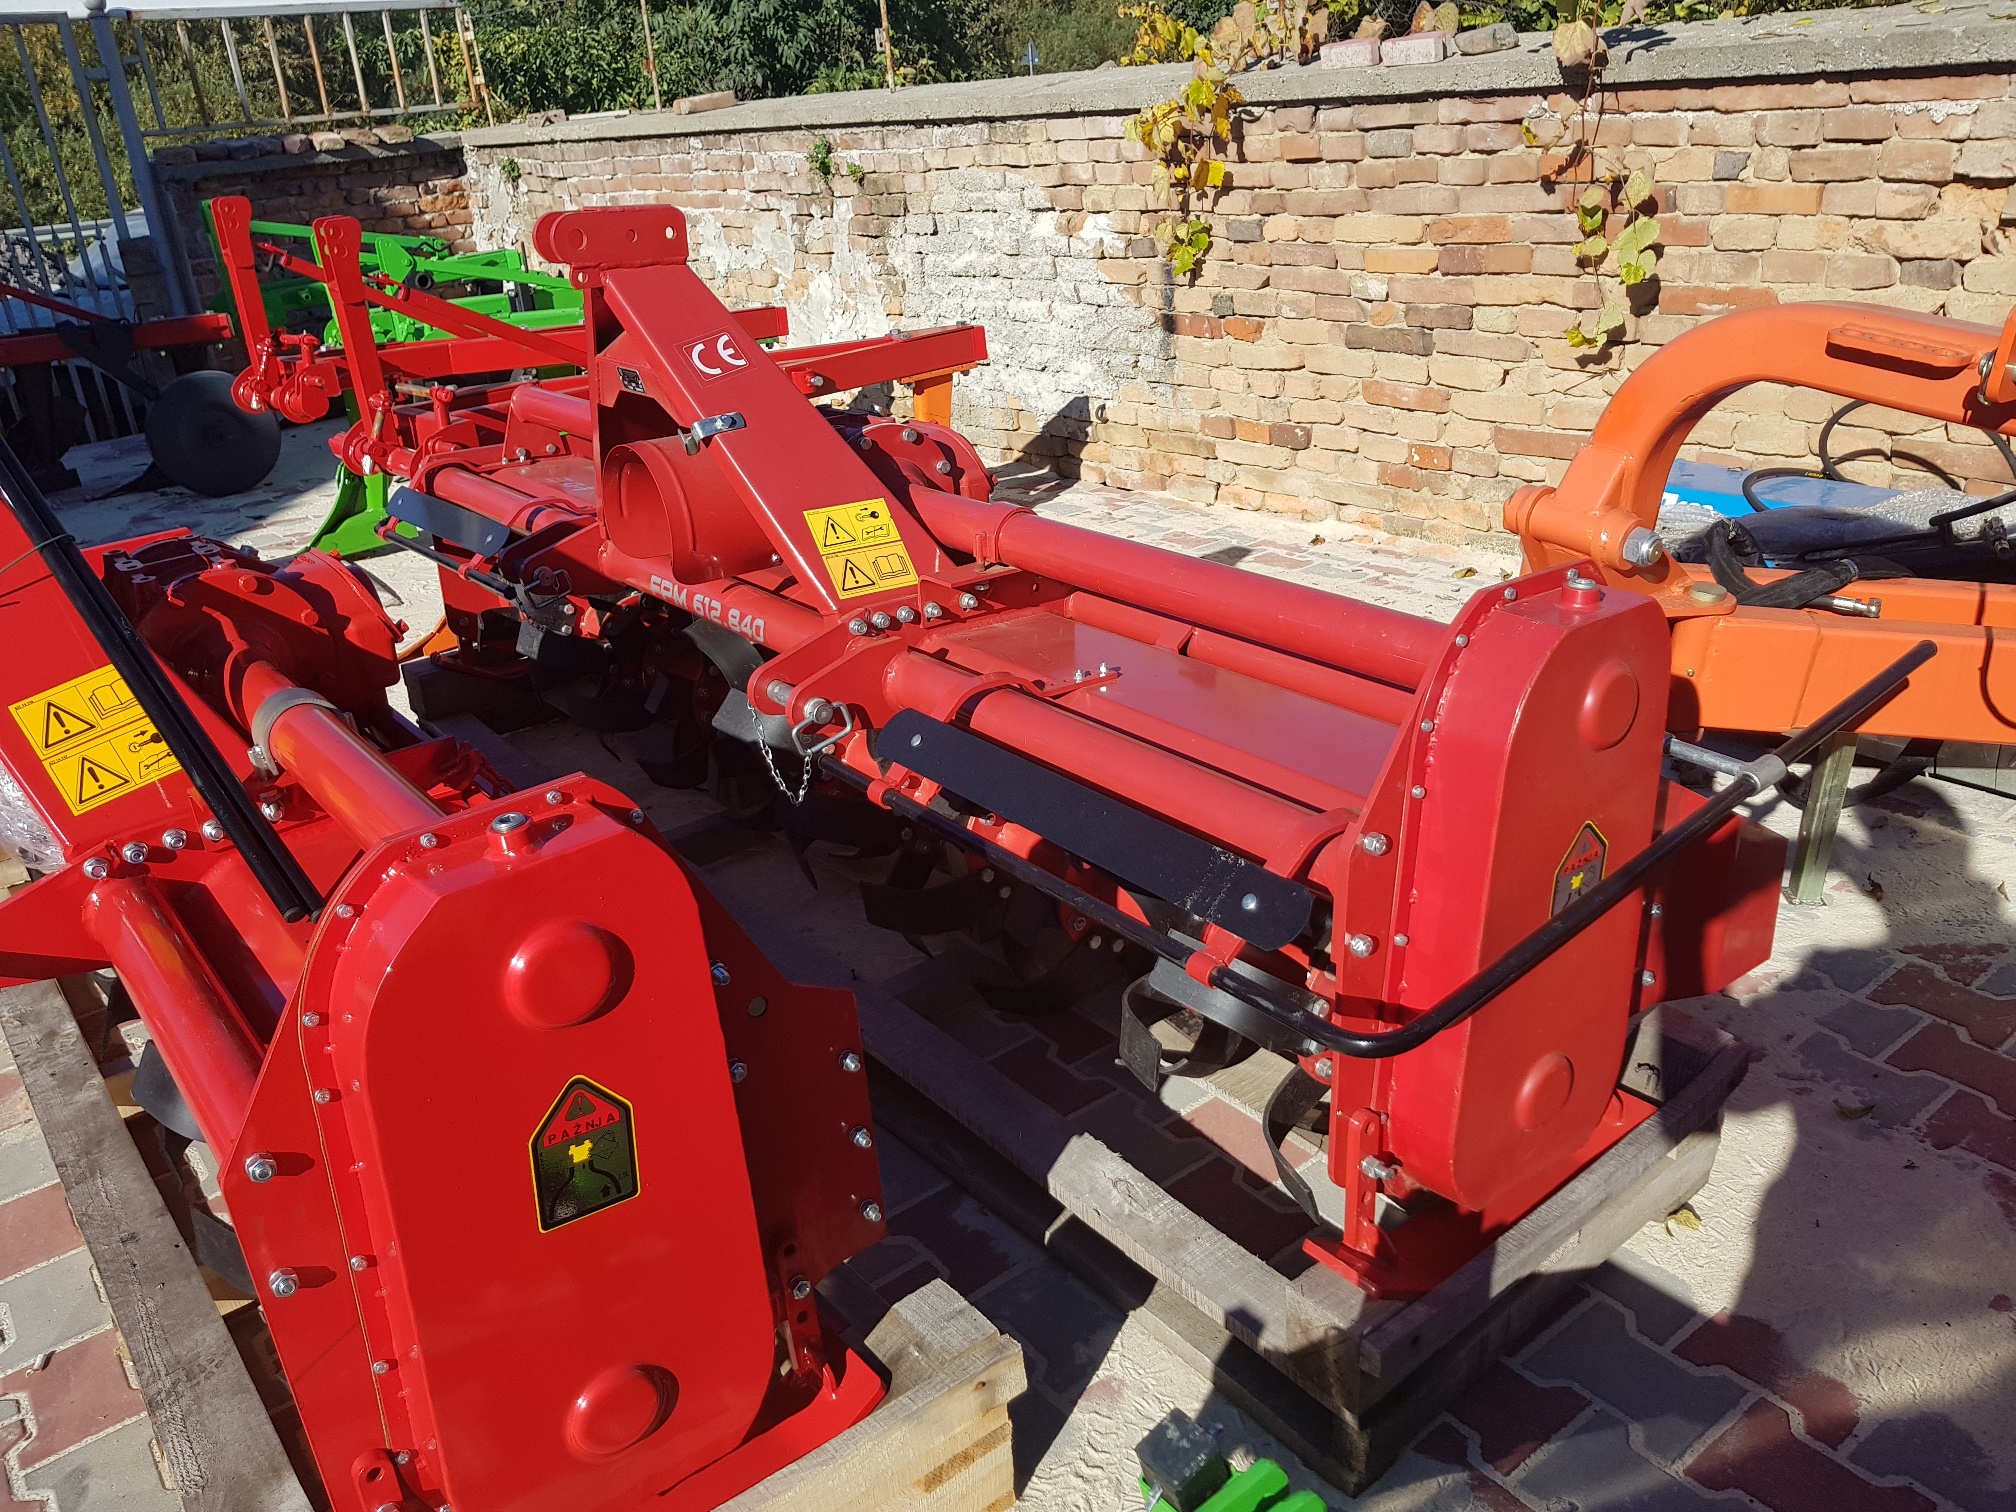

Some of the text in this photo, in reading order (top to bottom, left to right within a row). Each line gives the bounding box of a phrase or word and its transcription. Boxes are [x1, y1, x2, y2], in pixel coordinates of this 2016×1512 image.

[691, 334, 747, 375] CE
[650, 574, 689, 610] FPM
[547, 1111, 616, 1145] PAŽNJA
